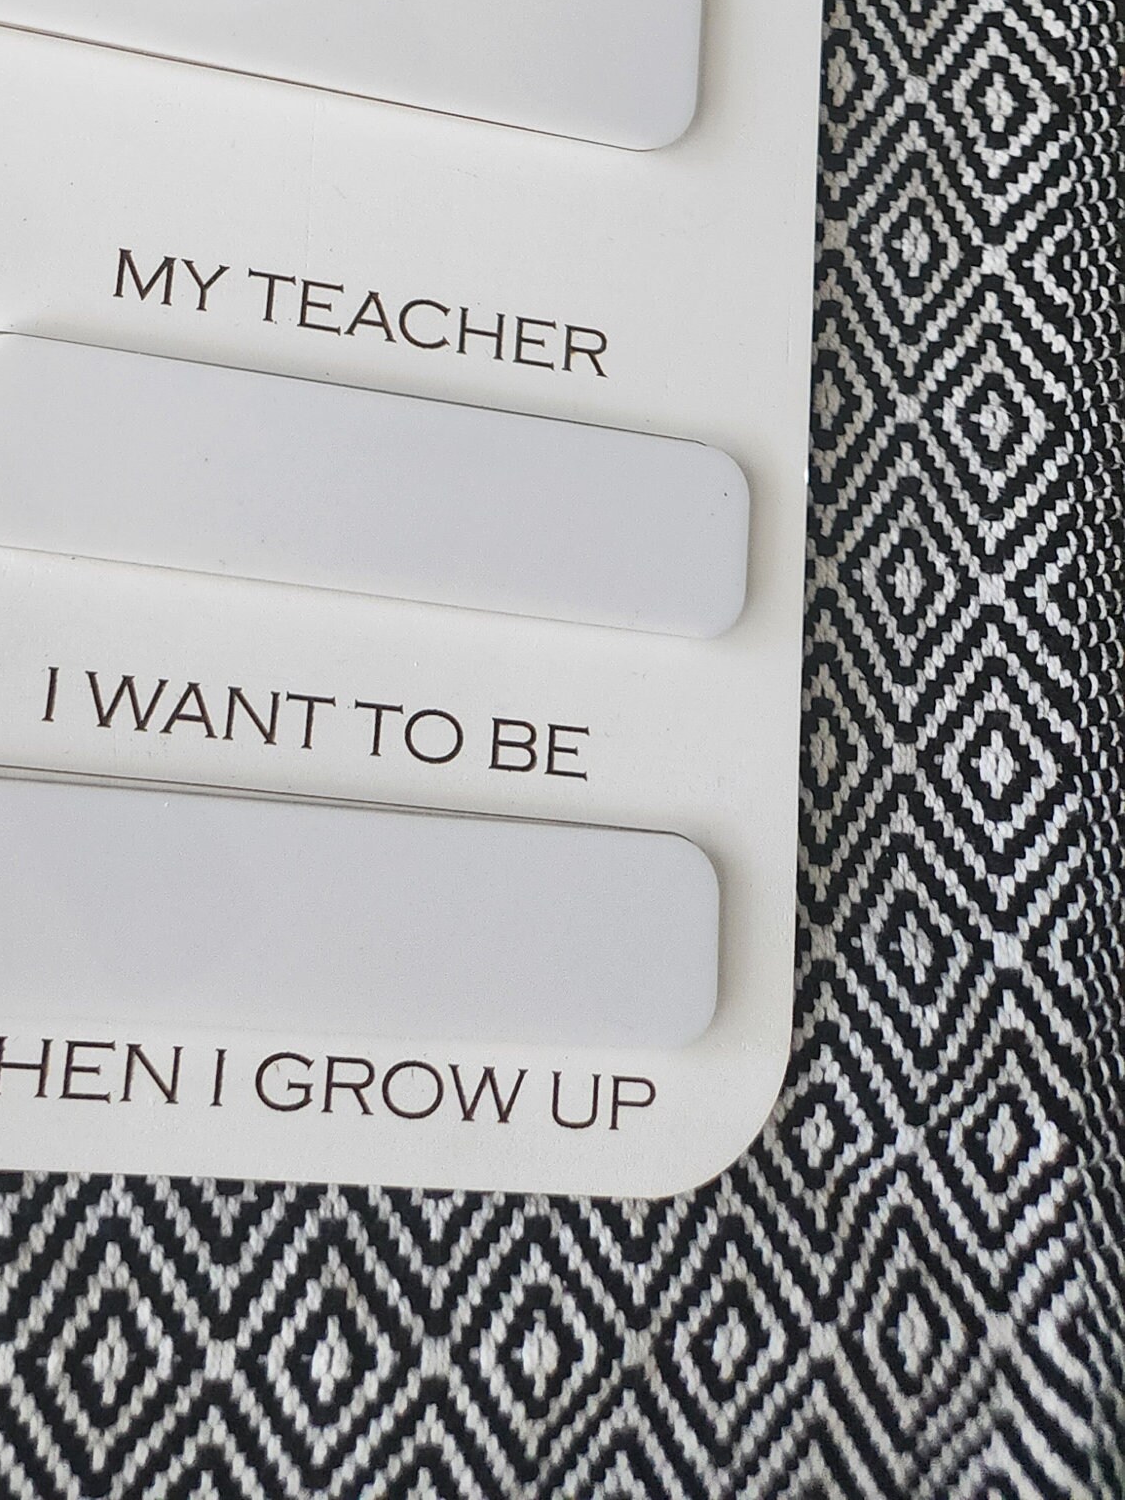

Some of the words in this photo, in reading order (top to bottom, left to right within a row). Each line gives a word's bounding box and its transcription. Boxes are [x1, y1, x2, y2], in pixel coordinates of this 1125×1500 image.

[112, 248, 230, 312] MY
[248, 267, 609, 378] TEACHER
[41, 666, 59, 723] I
[85, 670, 337, 750] WANT
[354, 699, 464, 765] TO
[488, 717, 590, 782] BE
[210, 1048, 227, 1107] I
[254, 1051, 529, 1124] GROW
[551, 1071, 656, 1131] UP
